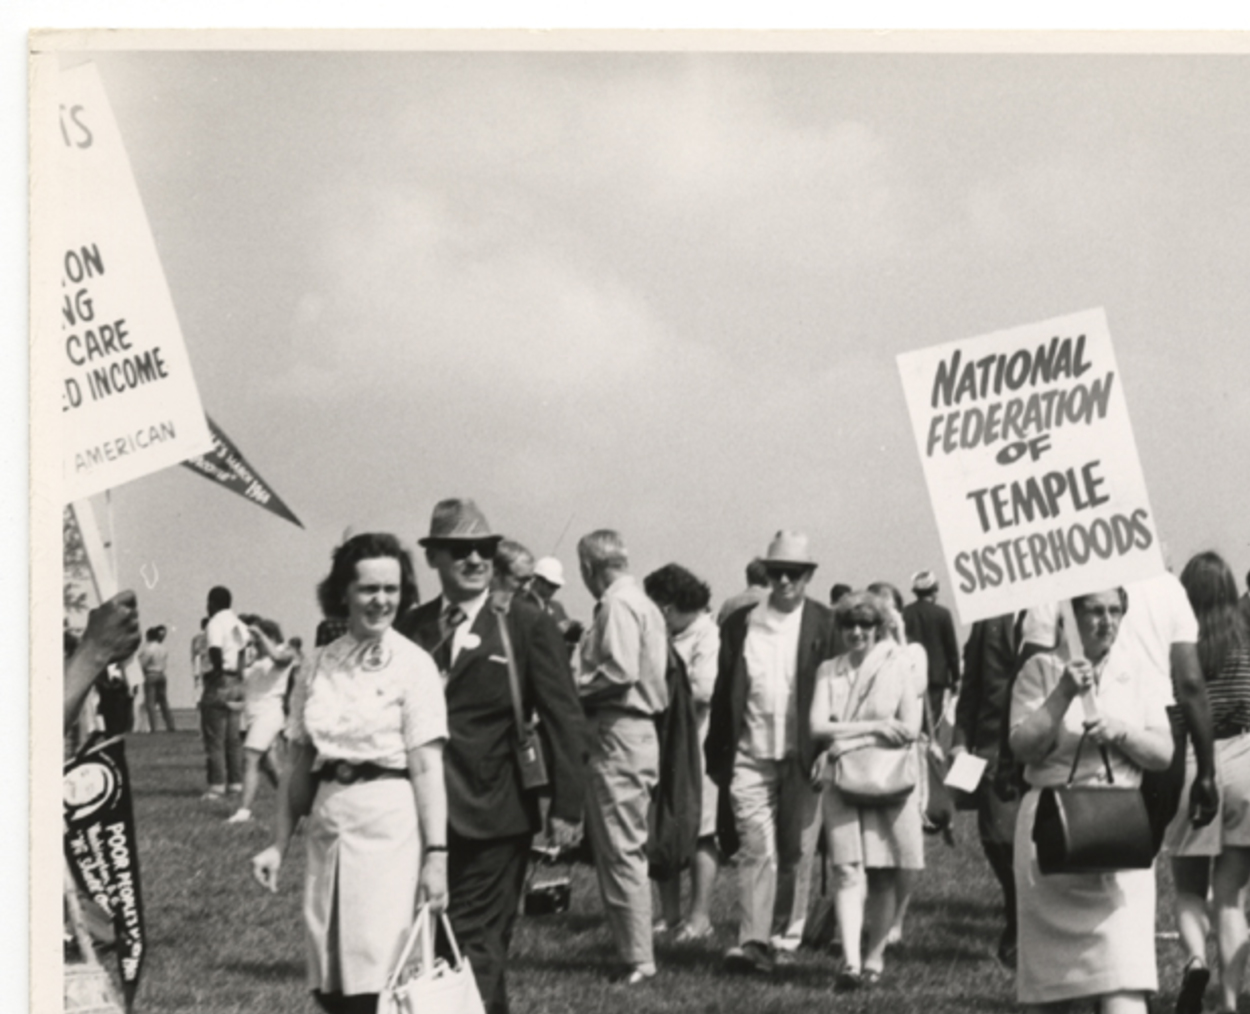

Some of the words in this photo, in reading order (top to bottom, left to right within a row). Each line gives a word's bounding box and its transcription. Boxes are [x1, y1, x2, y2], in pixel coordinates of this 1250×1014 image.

[62, 243, 104, 287] ON
[66, 318, 132, 366] CARE
[86, 346, 168, 401] INCOME
[931, 334, 1092, 408] NATIONAL
[926, 371, 1114, 457] FEDERATION
[75, 420, 176, 474] AMERICAN
[995, 433, 1052, 466] OF
[965, 460, 1110, 533] TEMPLE
[954, 508, 1153, 593] SISTERHOODS
[105, 821, 131, 871] POOR
